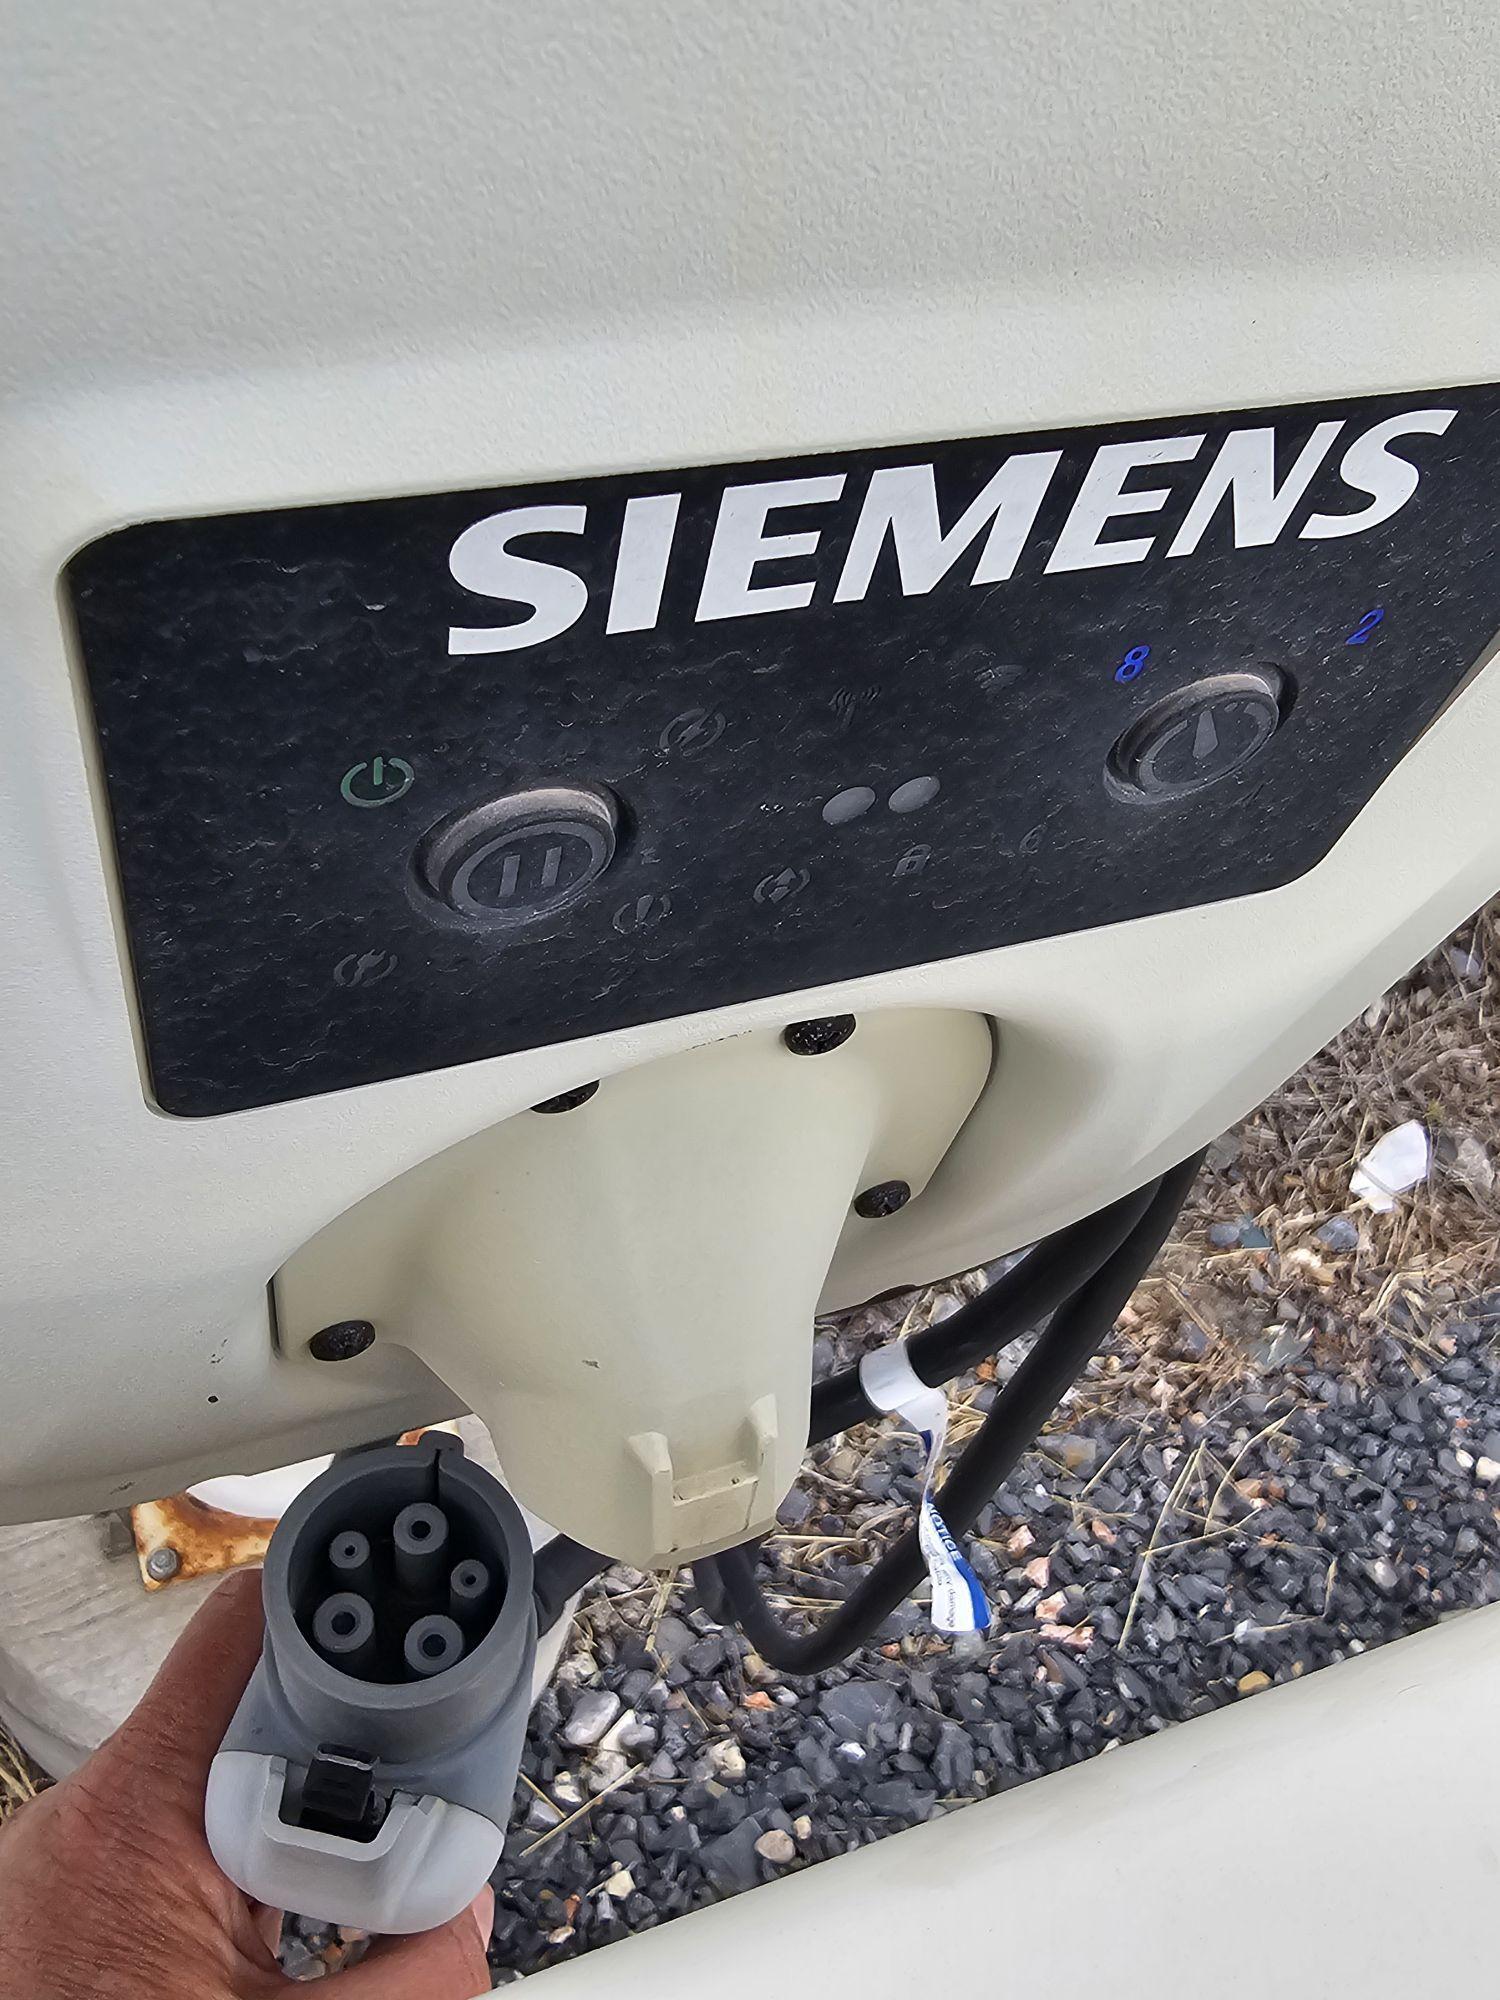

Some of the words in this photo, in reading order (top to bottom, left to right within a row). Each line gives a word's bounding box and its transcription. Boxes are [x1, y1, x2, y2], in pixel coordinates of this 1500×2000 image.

[447, 409, 1459, 655] SIEMENS
[1345, 609, 1385, 645] 2
[1114, 645, 1150, 683] 8
[926, 1502, 963, 1561] NOTICE
